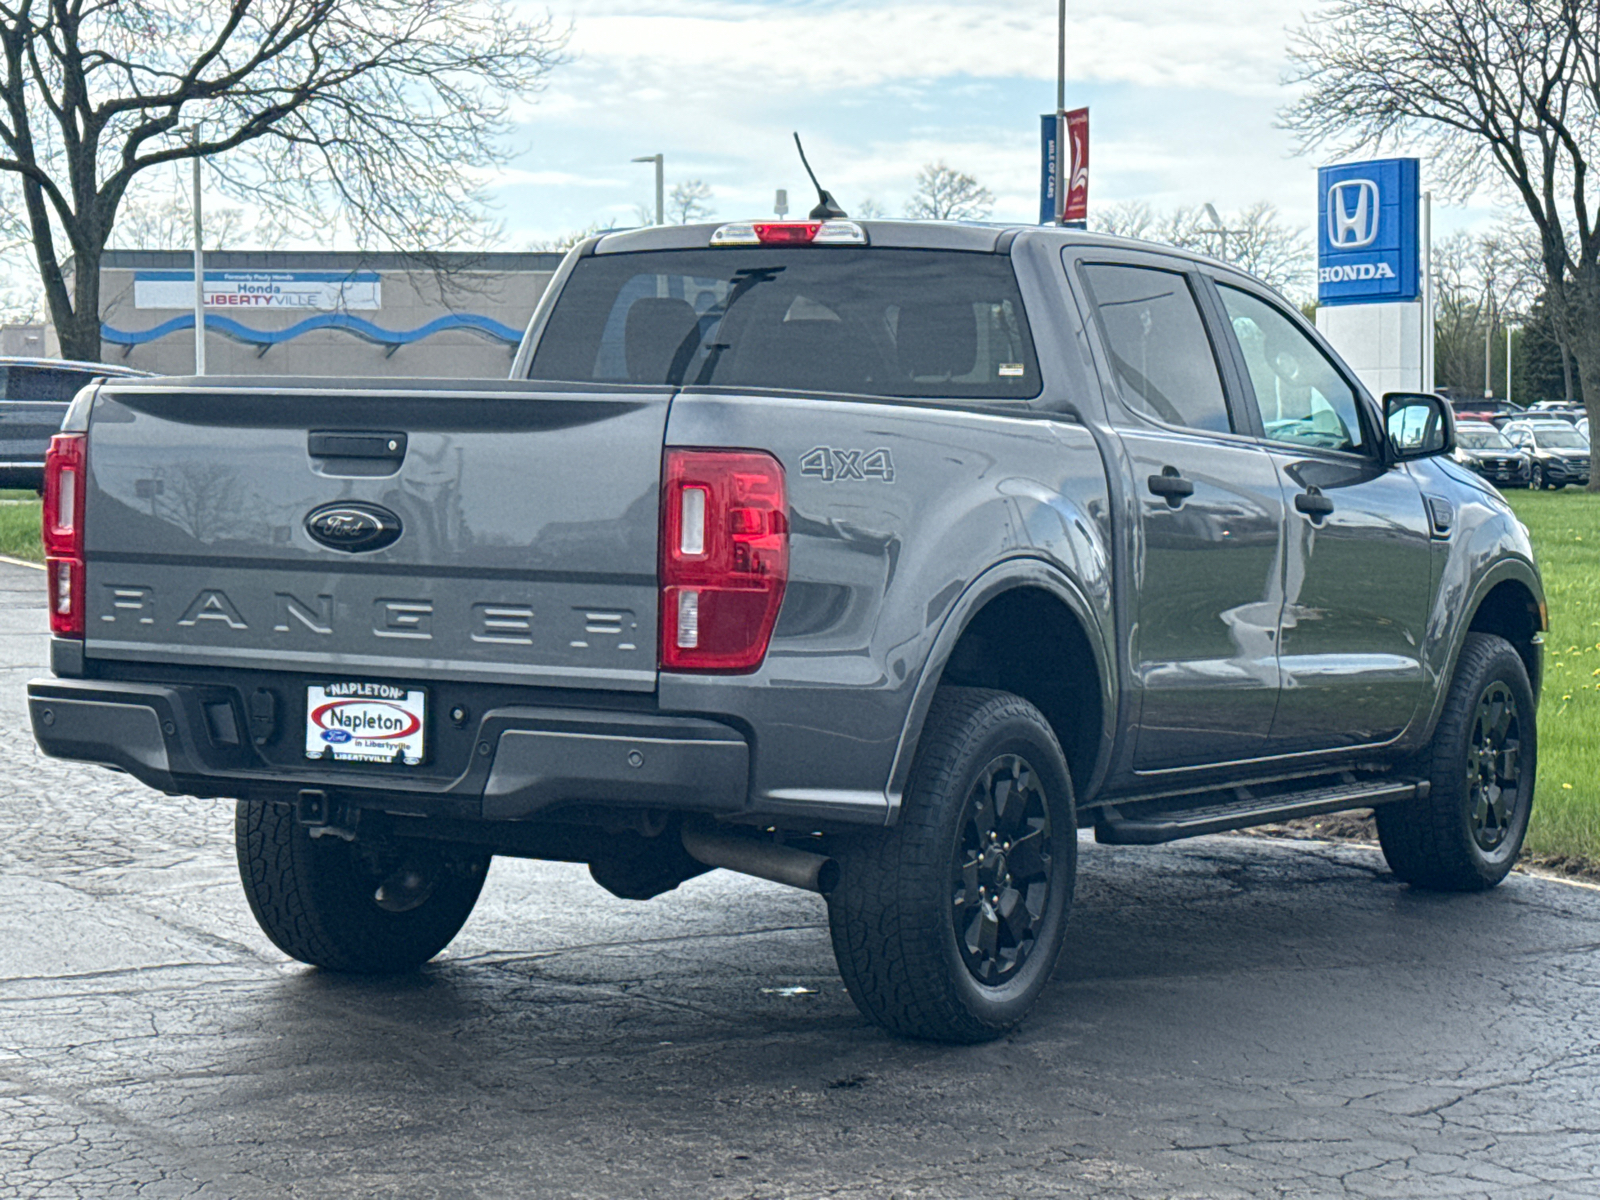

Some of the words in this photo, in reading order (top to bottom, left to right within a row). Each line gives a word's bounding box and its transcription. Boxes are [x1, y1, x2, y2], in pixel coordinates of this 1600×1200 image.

[1048, 162, 1055, 174] OF
[1047, 175, 1055, 199] CARS
[1318, 262, 1396, 283] HONDA
[237, 283, 281, 294] Honda
[323, 515, 363, 536] Ford
[102, 583, 637, 651] RANGER
[330, 683, 399, 699] NAPLETON
[330, 708, 403, 732] Napleton
[354, 739, 362, 748] in
[364, 739, 411, 750] Libertyville
[334, 752, 393, 763] LIBERTYVILLE
